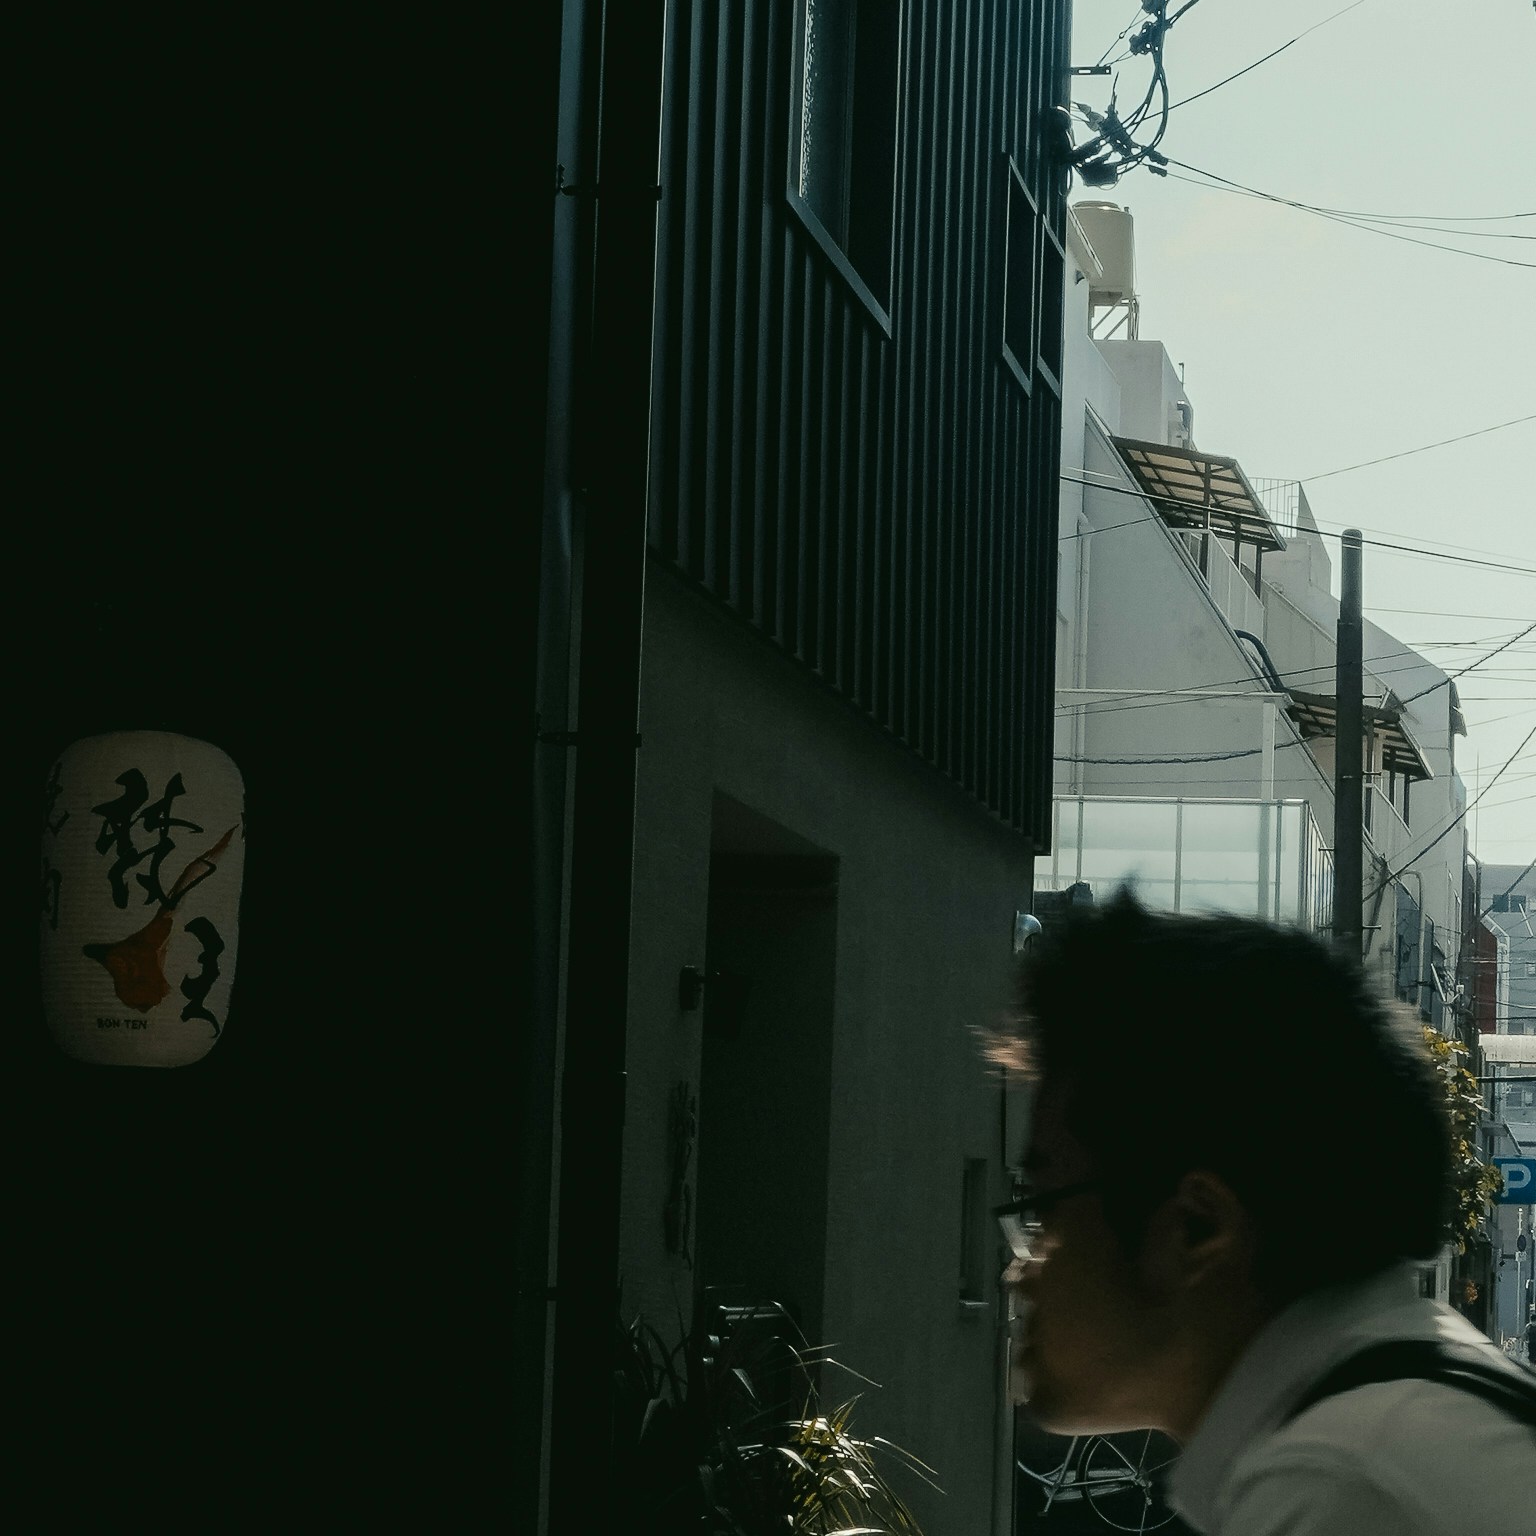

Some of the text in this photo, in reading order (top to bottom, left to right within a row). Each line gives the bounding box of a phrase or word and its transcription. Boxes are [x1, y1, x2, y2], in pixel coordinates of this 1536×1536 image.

[97, 1018, 148, 1030] BON TEN
[1501, 1163, 1532, 1199] P
